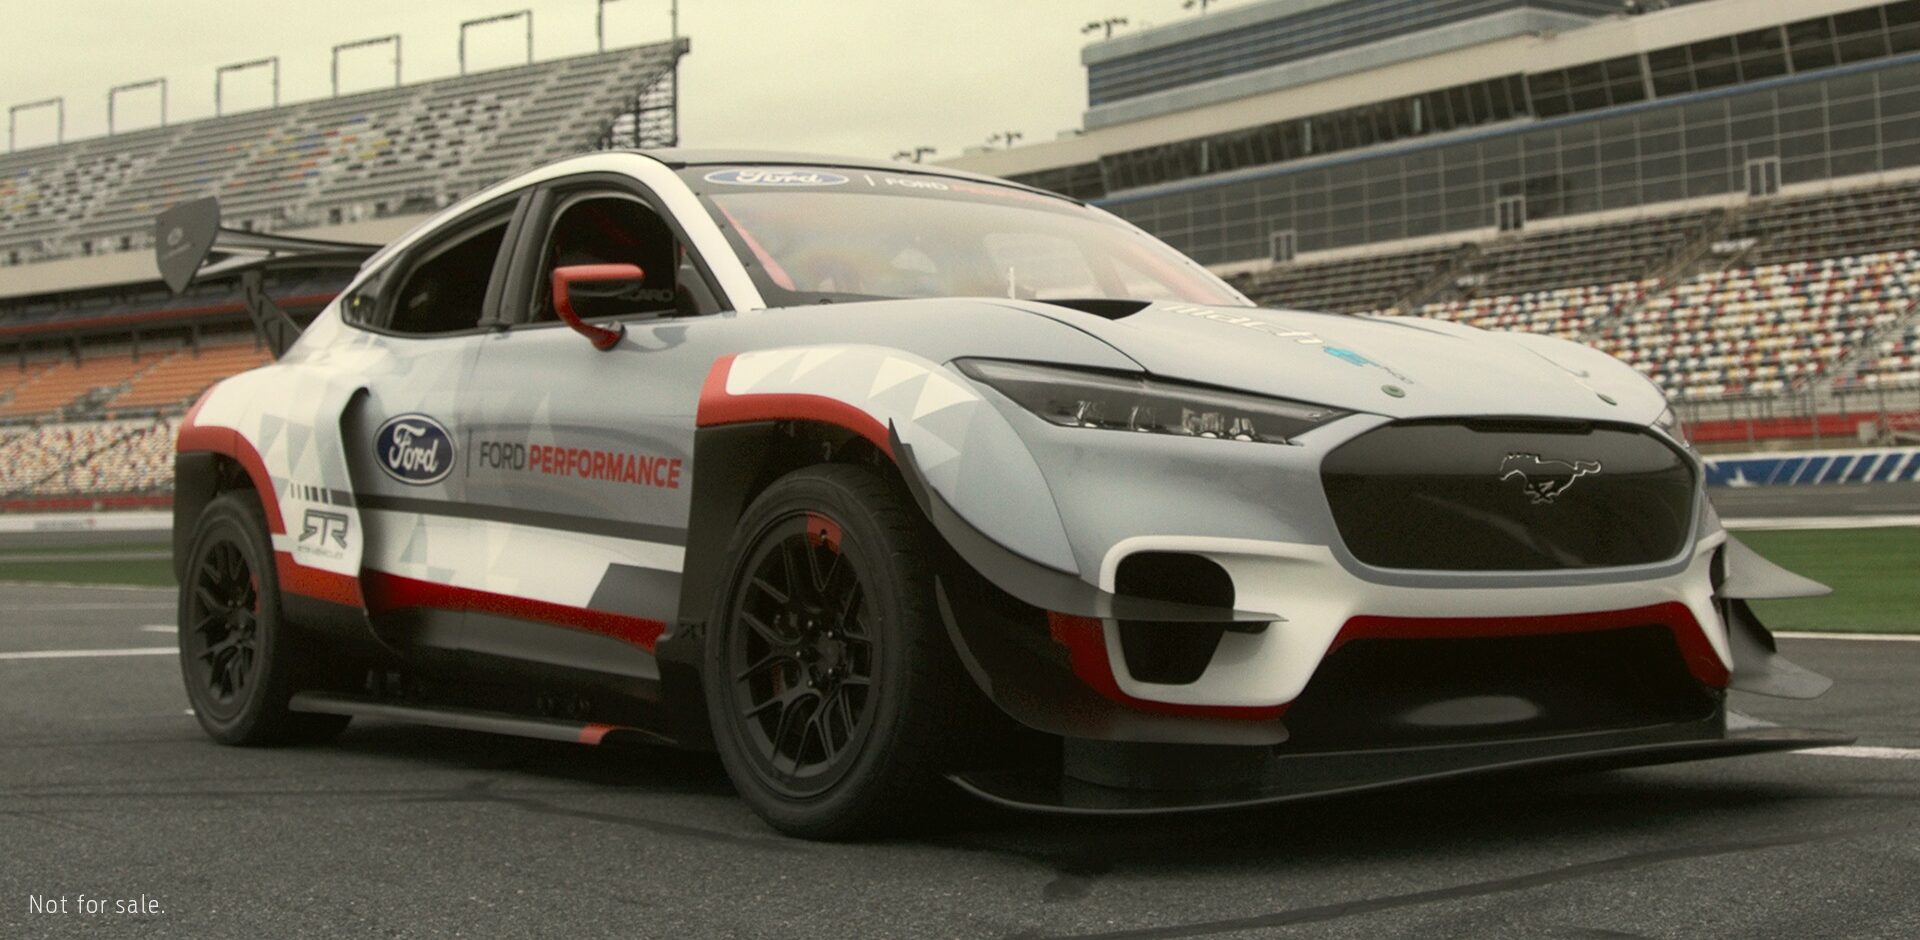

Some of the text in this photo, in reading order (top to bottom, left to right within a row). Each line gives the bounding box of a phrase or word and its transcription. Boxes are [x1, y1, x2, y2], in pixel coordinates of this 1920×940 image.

[735, 170, 949, 191] Ford FORD
[388, 422, 683, 489] Ford FORD PERFORMANCE
